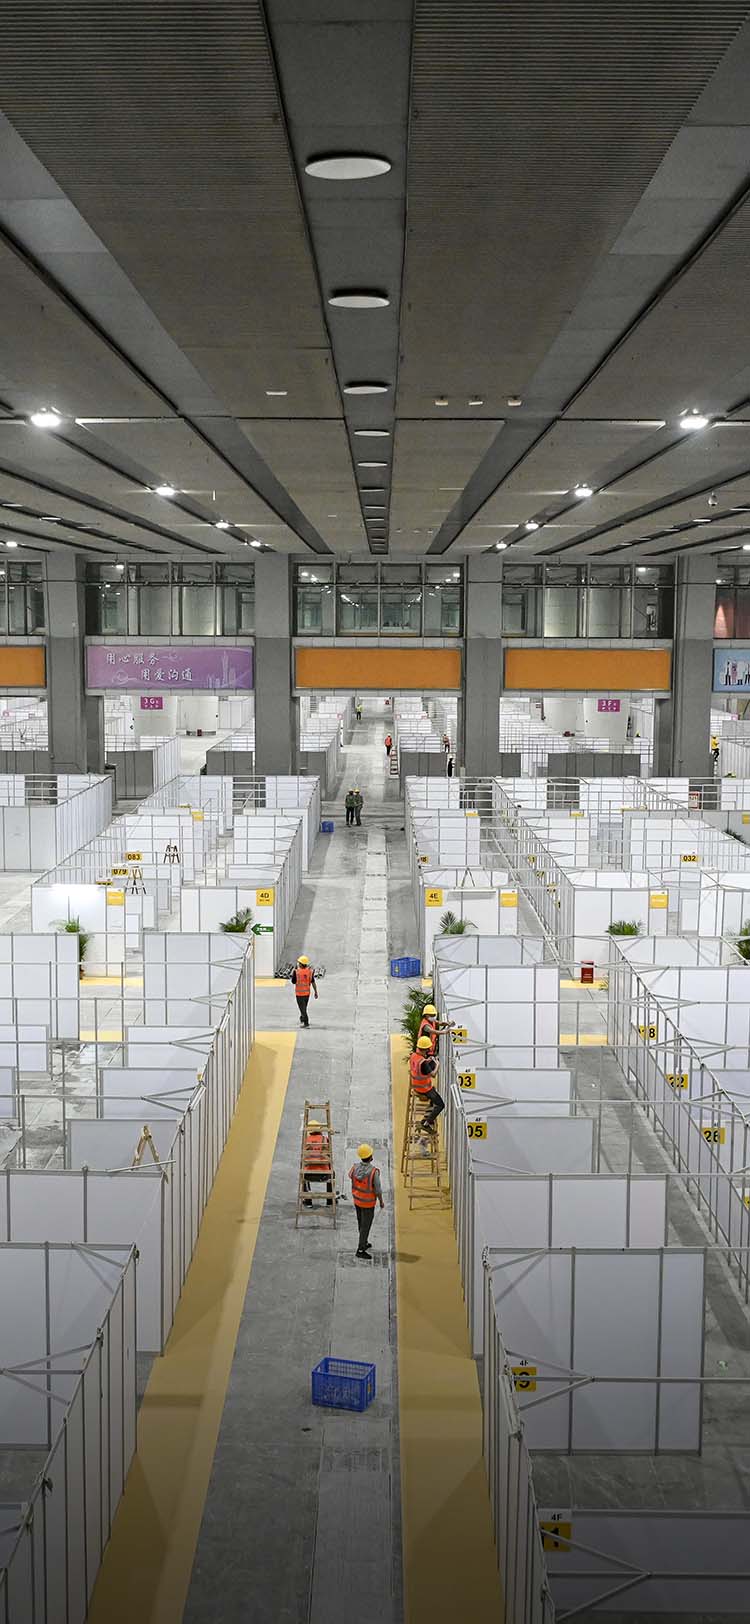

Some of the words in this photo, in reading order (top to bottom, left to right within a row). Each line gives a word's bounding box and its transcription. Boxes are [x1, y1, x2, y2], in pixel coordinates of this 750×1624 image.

[106, 652, 160, 665] 用心服务
[142, 668, 193, 681] 用爱沟通
[551, 1513, 563, 1521] 4F
